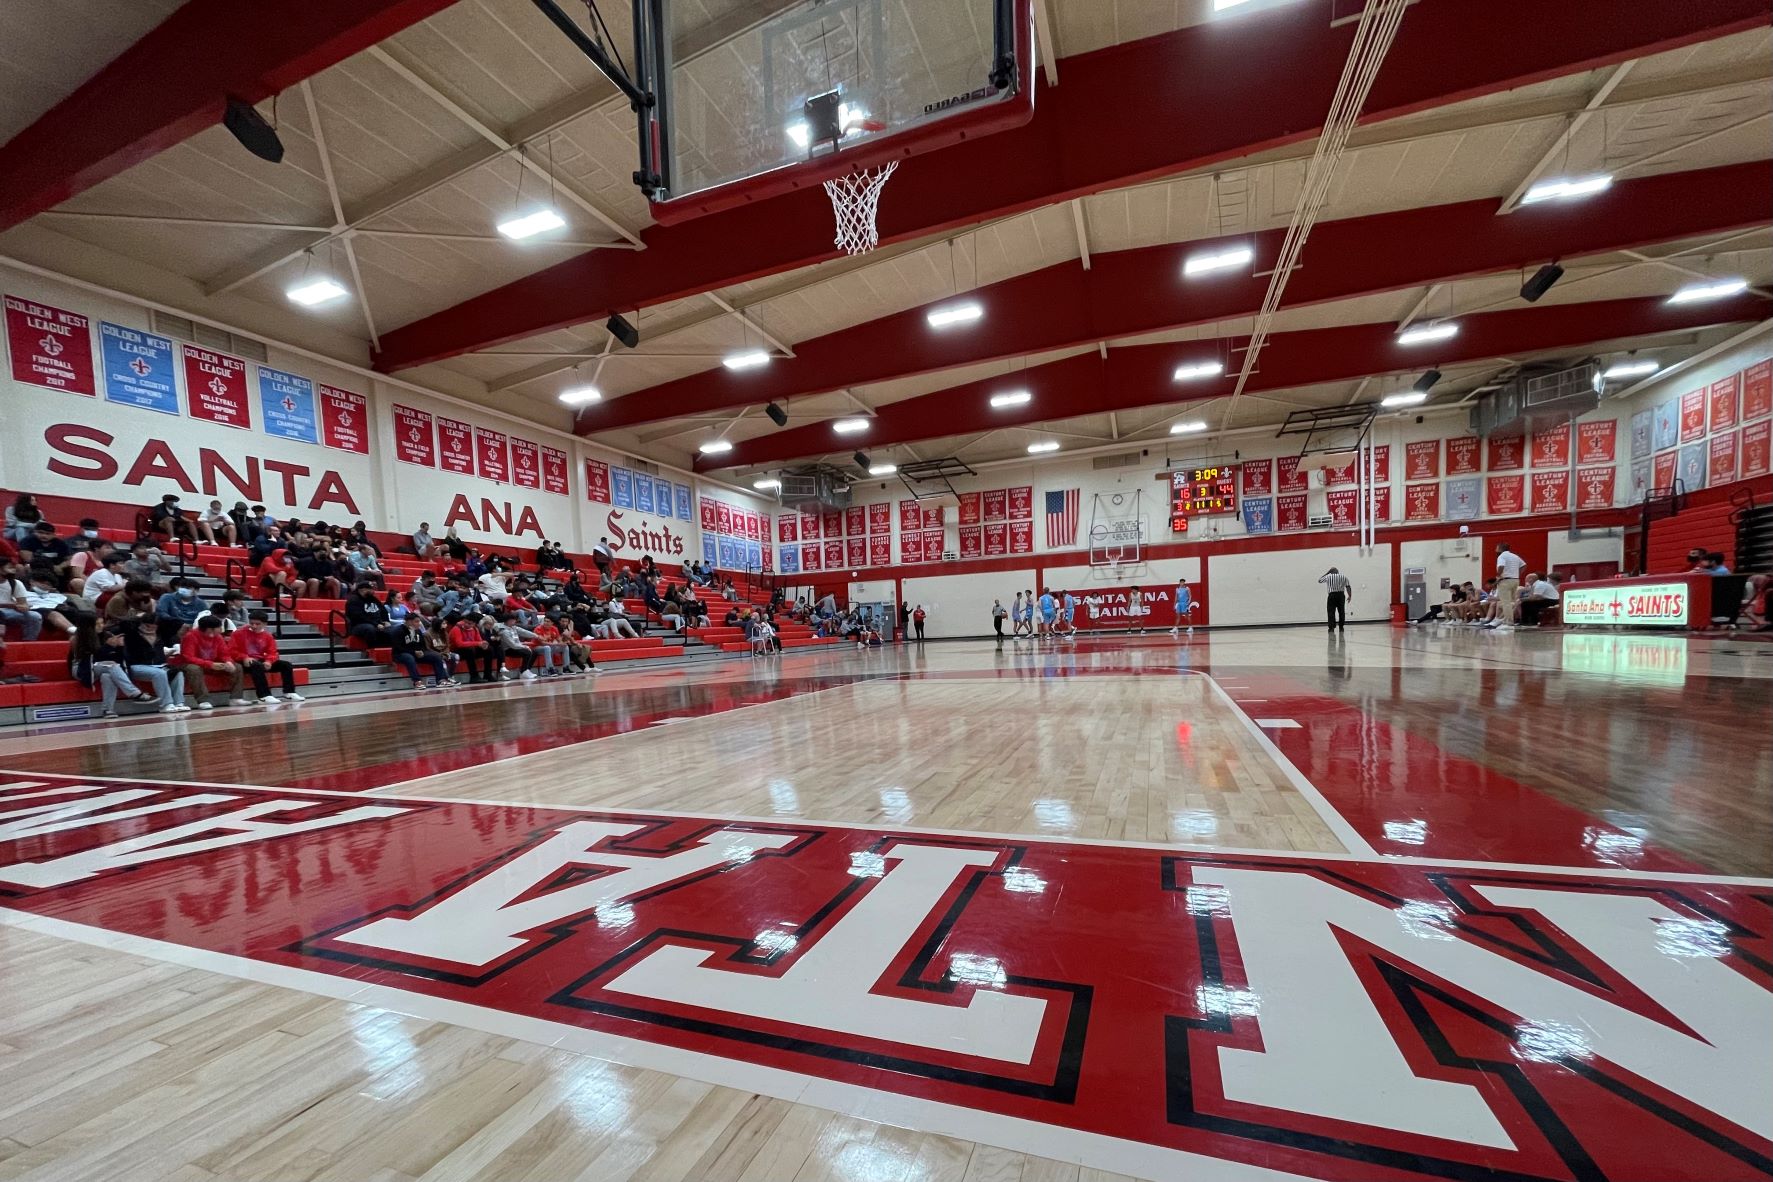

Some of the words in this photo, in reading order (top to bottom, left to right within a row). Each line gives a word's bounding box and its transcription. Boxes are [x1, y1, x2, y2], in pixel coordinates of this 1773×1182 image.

[7, 299, 52, 319] GOLDEN
[58, 312, 88, 328] WEST
[27, 316, 72, 336] LEAGUE
[103, 325, 141, 343] GOLDEN
[147, 337, 171, 351] WEST
[120, 341, 158, 358] LEAGUE
[32, 355, 73, 370] FOOTBALL
[185, 348, 218, 364] GOLDEN
[223, 358, 244, 370] WEST
[33, 365, 76, 379] CHAMPIONS
[200, 362, 232, 378] LEAGUE
[113, 374, 136, 384] CROSS
[140, 380, 169, 392] COUNTRY
[260, 370, 288, 384] GOLDEN
[292, 378, 310, 389] WEST
[124, 384, 162, 398] CHAMPIONS
[273, 382, 300, 396] LEAGUE
[321, 386, 345, 399] GOLDEN
[349, 394, 365, 404] WEST
[200, 394, 238, 408] VOLLEYBALL
[332, 399, 356, 411] LEAGUE
[204, 403, 236, 415] CHAMPIONS
[395, 407, 415, 418] GOLDEN
[418, 413, 432, 422] WEST
[403, 417, 424, 428] LEAGUE
[439, 420, 456, 428] GOLDEN
[459, 424, 471, 432] WEST
[1581, 422, 1612, 430] CENTURY
[446, 428, 464, 438] LEAGUE
[477, 429, 493, 438] GOLDEN
[484, 438, 500, 448] LEAGUE
[1408, 442, 1436, 450] CENTURY
[1450, 444, 1476, 452] LEAGUE
[44, 423, 361, 515] SANTA
[1195, 468, 1218, 481] 3:09
[1580, 468, 1612, 476] CENTURY
[1534, 472, 1566, 480] CENTURY
[1536, 478, 1564, 486] LEAGUE
[1180, 488, 1190, 498] 16
[1200, 488, 1206, 496] 3
[1220, 484, 1234, 494] 44
[1330, 498, 1354, 506] LEAGUE
[444, 494, 545, 539] ANA
[1174, 518, 1187, 530] 35
[607, 510, 684, 555] Saints
[1144, 592, 1169, 602] NA
[1567, 600, 1588, 614] Santa
[1588, 600, 1604, 614] Ana
[1628, 594, 1684, 618] SAINTS
